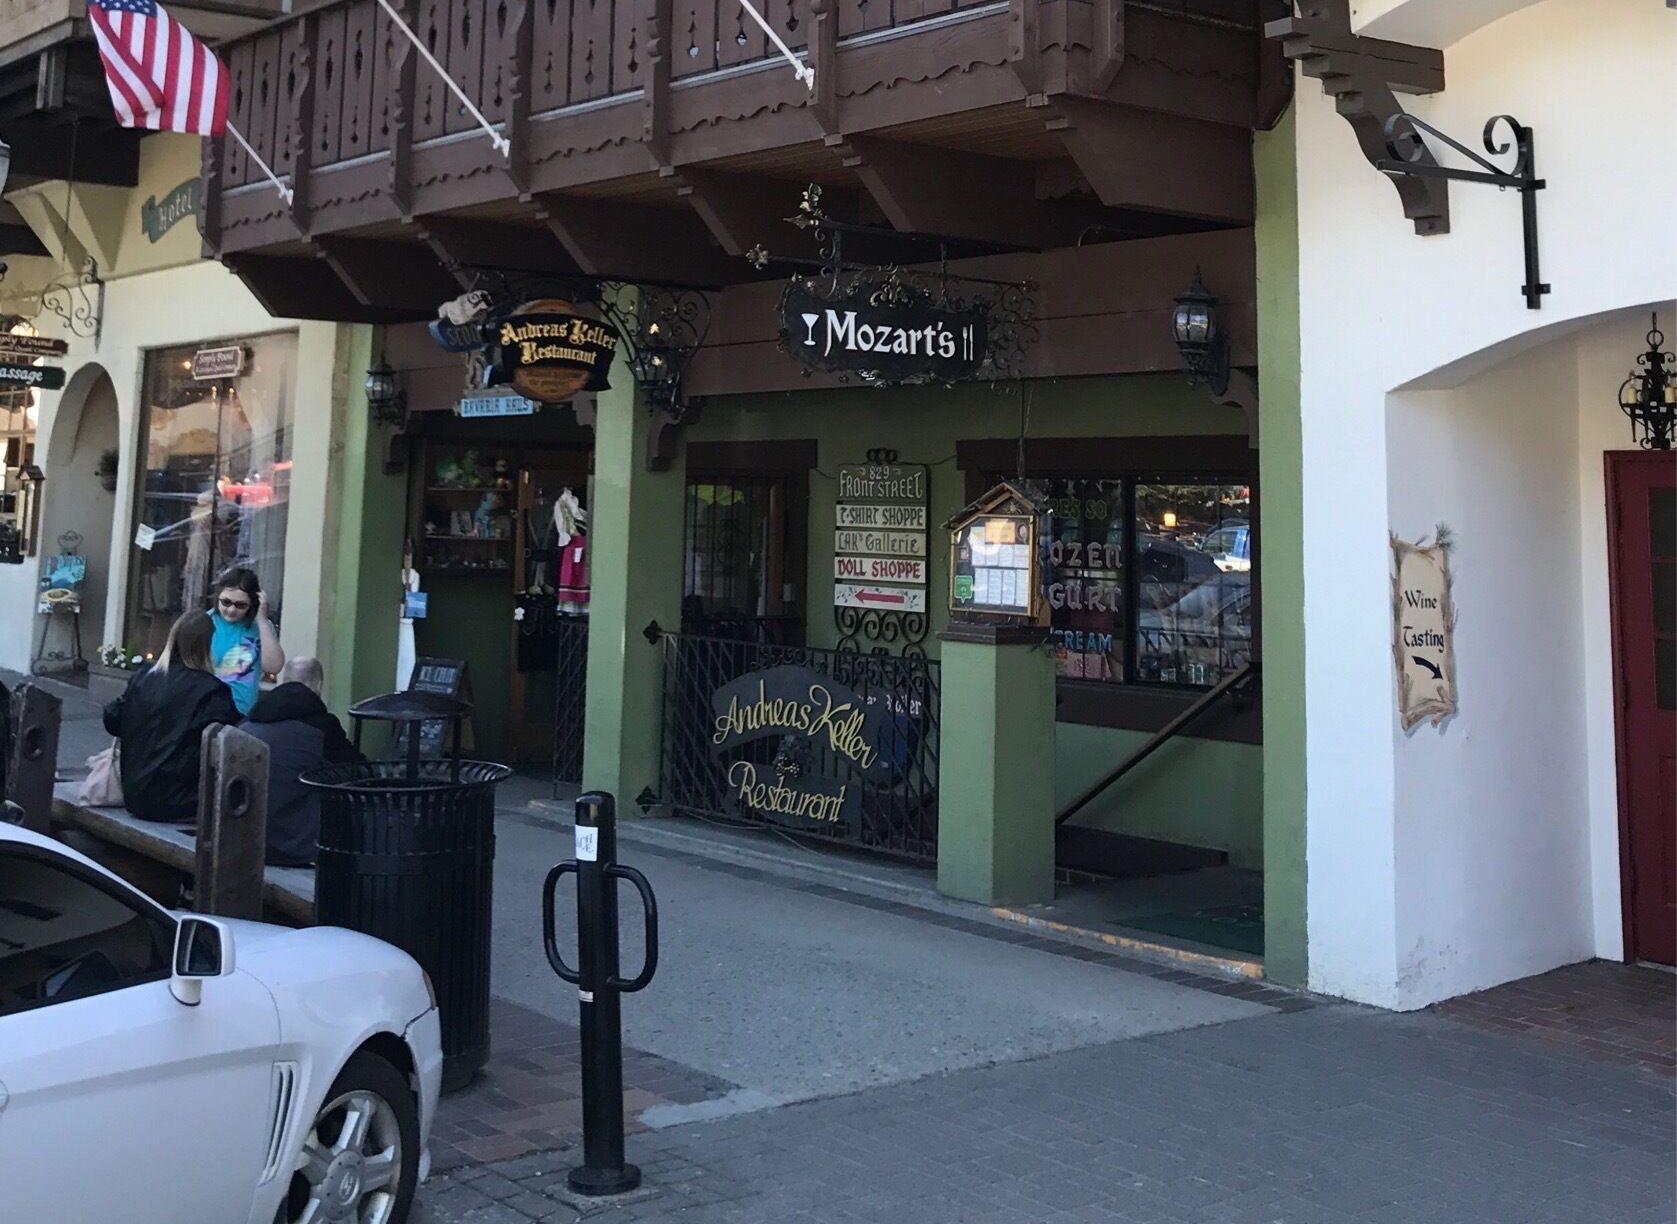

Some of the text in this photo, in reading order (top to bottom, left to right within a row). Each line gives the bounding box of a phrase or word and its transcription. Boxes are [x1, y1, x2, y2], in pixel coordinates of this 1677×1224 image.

[158, 187, 192, 232] Hotel
[500, 319, 617, 350] Andreas Keller
[824, 309, 956, 358] Mozart's
[519, 341, 598, 365] Restaurant
[839, 470, 923, 498] FRONT STREET
[869, 466, 890, 480] 829
[840, 507, 923, 527] T-SHIRT SHOPPE
[865, 533, 920, 553] Gallerie
[1049, 540, 1122, 569] OZEN
[837, 558, 921, 579] DOLL SHOPPE
[1048, 582, 1121, 614] GURT
[1404, 589, 1438, 609] Wine
[1402, 626, 1445, 654] Tasting
[713, 679, 878, 770] Andreas Keller
[728, 761, 846, 823] Restaurant
